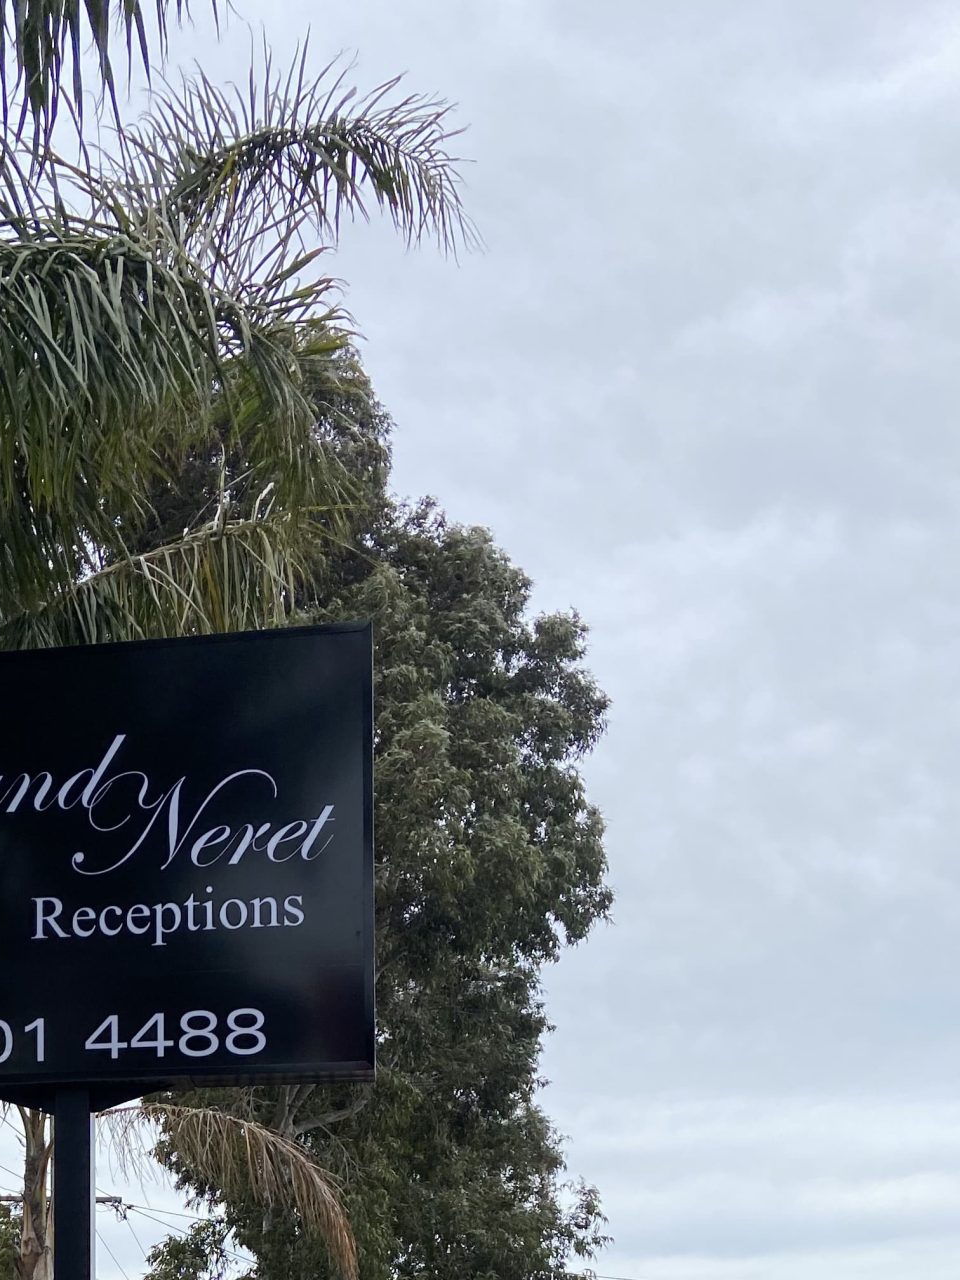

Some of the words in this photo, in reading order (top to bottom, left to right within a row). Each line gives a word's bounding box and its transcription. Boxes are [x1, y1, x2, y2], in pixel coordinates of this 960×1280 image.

[72, 769, 335, 875] Neret
[31, 885, 305, 946] Receptions
[85, 1007, 267, 1059] 4488
